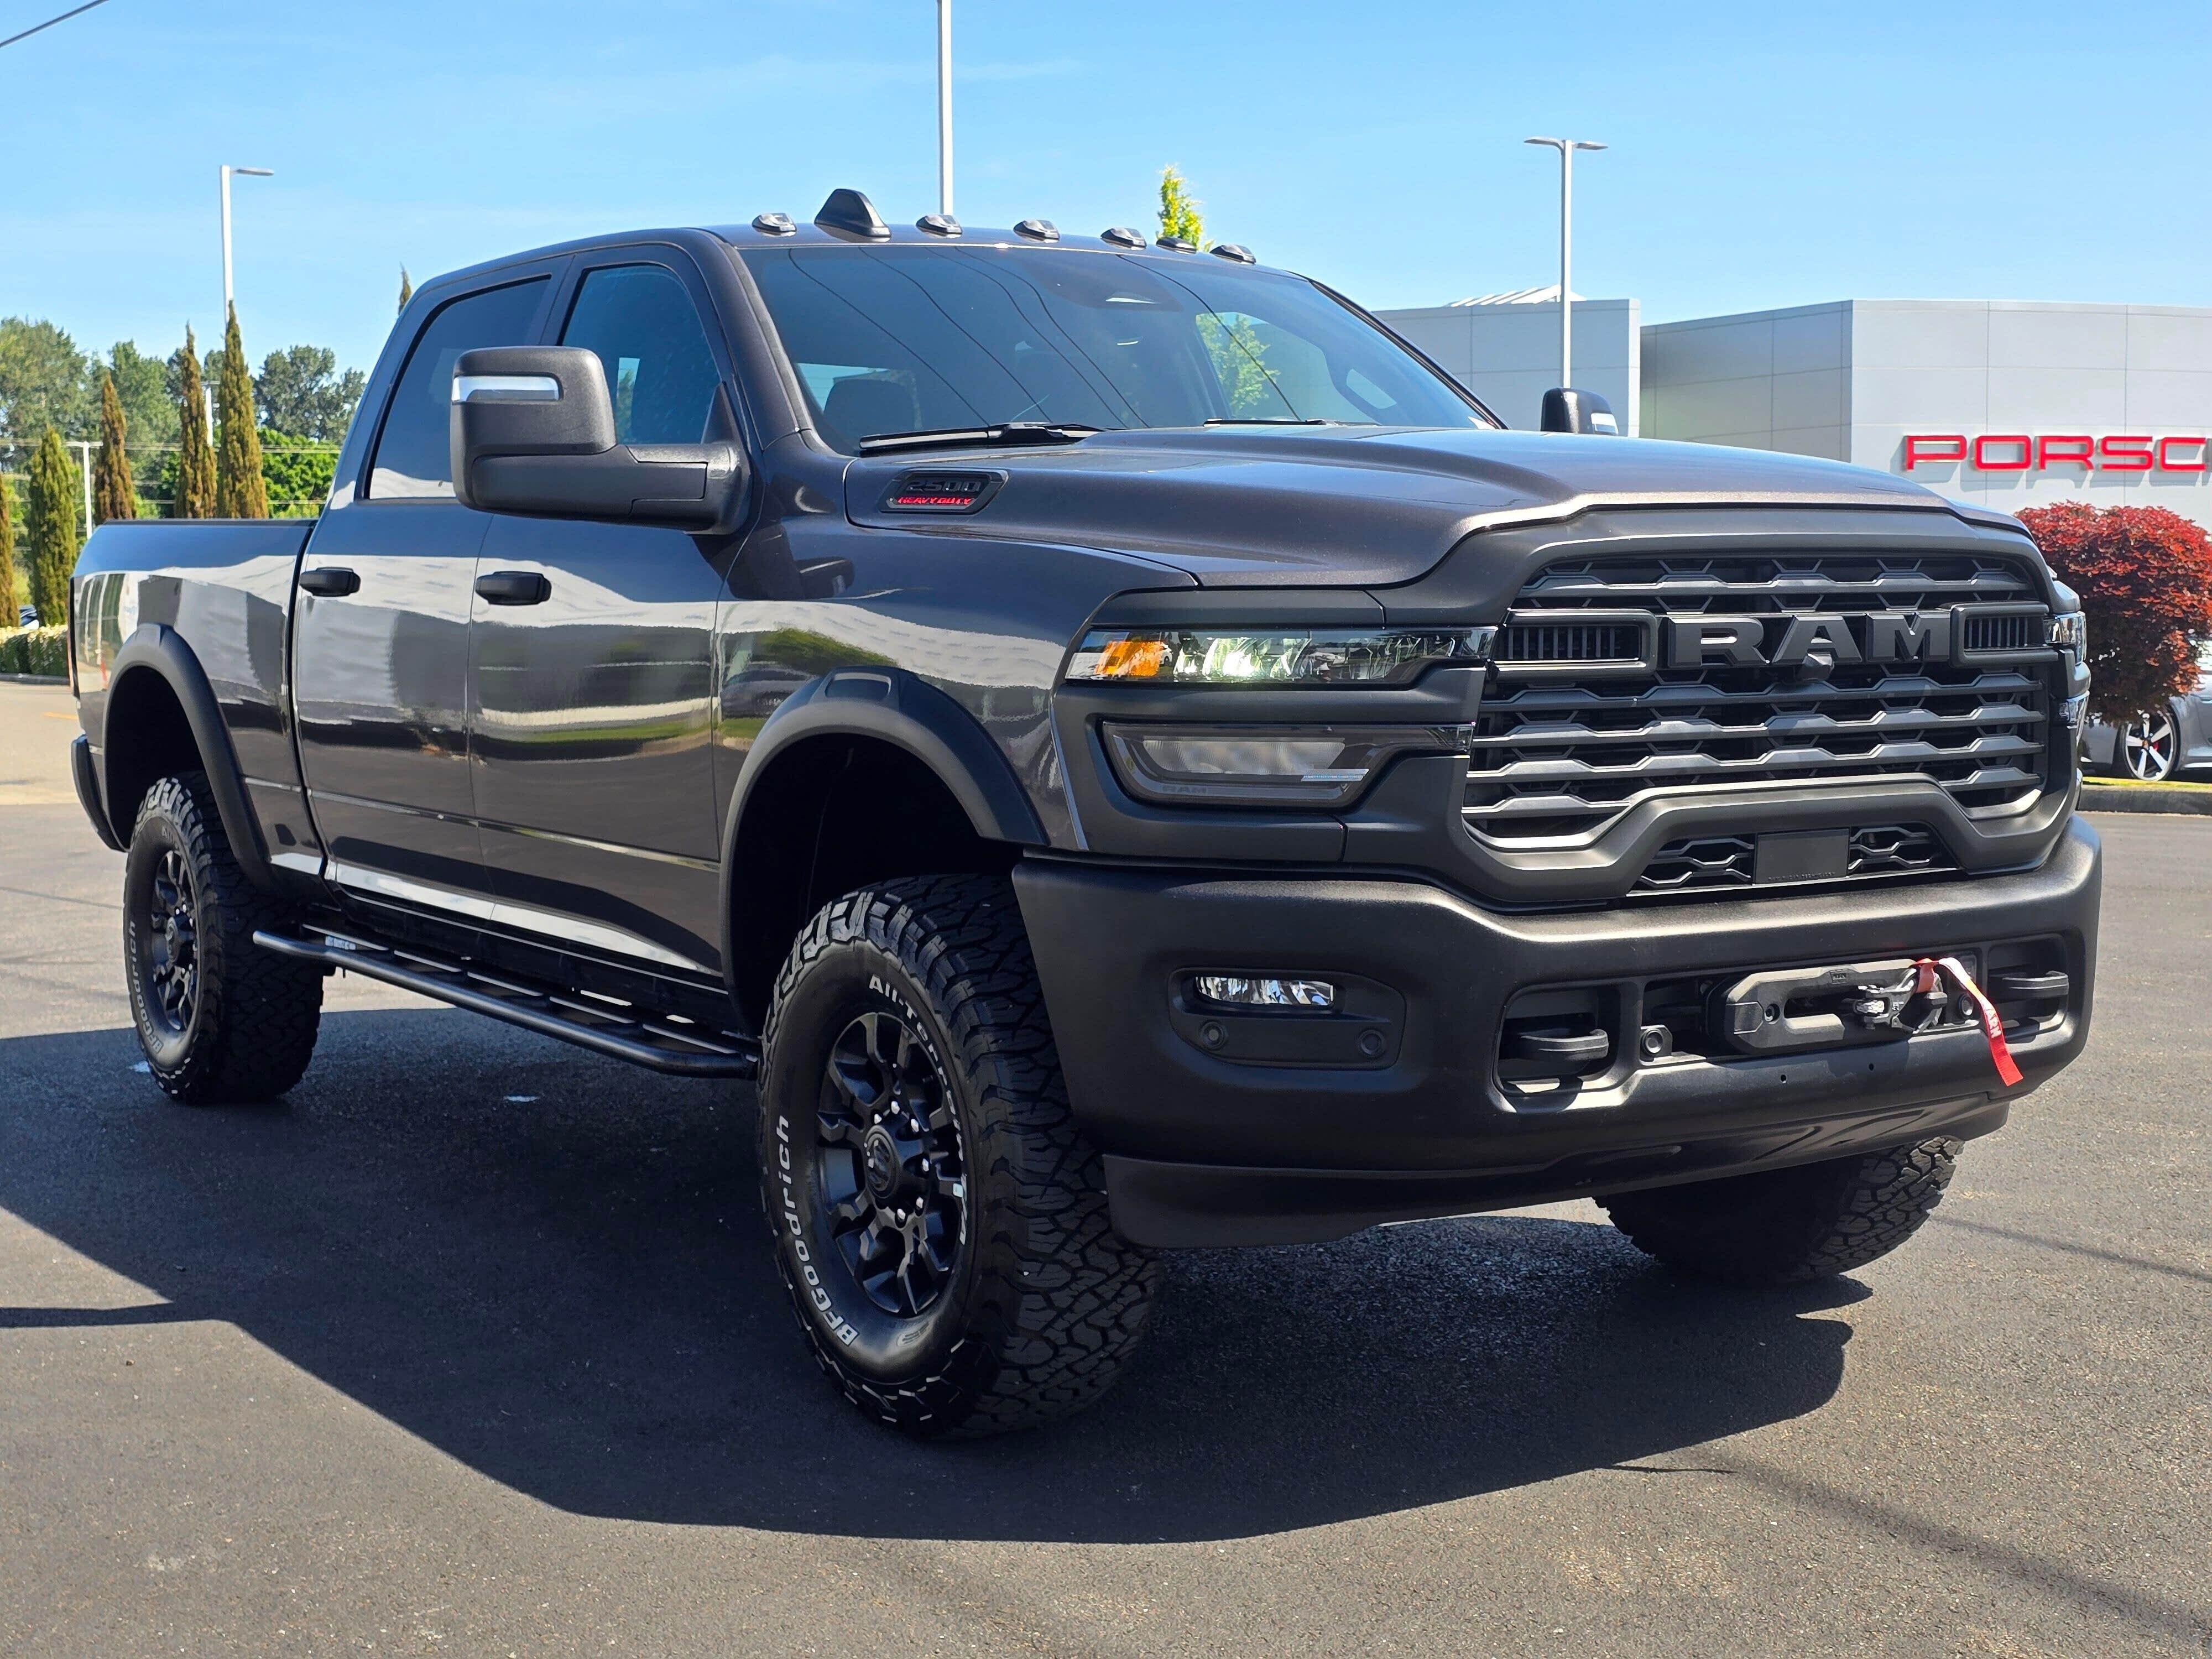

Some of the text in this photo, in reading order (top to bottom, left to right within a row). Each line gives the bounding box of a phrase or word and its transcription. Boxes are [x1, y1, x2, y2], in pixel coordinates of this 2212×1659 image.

[1906, 435, 2211, 472] PORSC
[906, 481, 982, 492] 2500
[937, 497, 972, 505] DUTY
[1668, 614, 1951, 667] RAM
[776, 1114, 859, 1346] BFGoodrich
